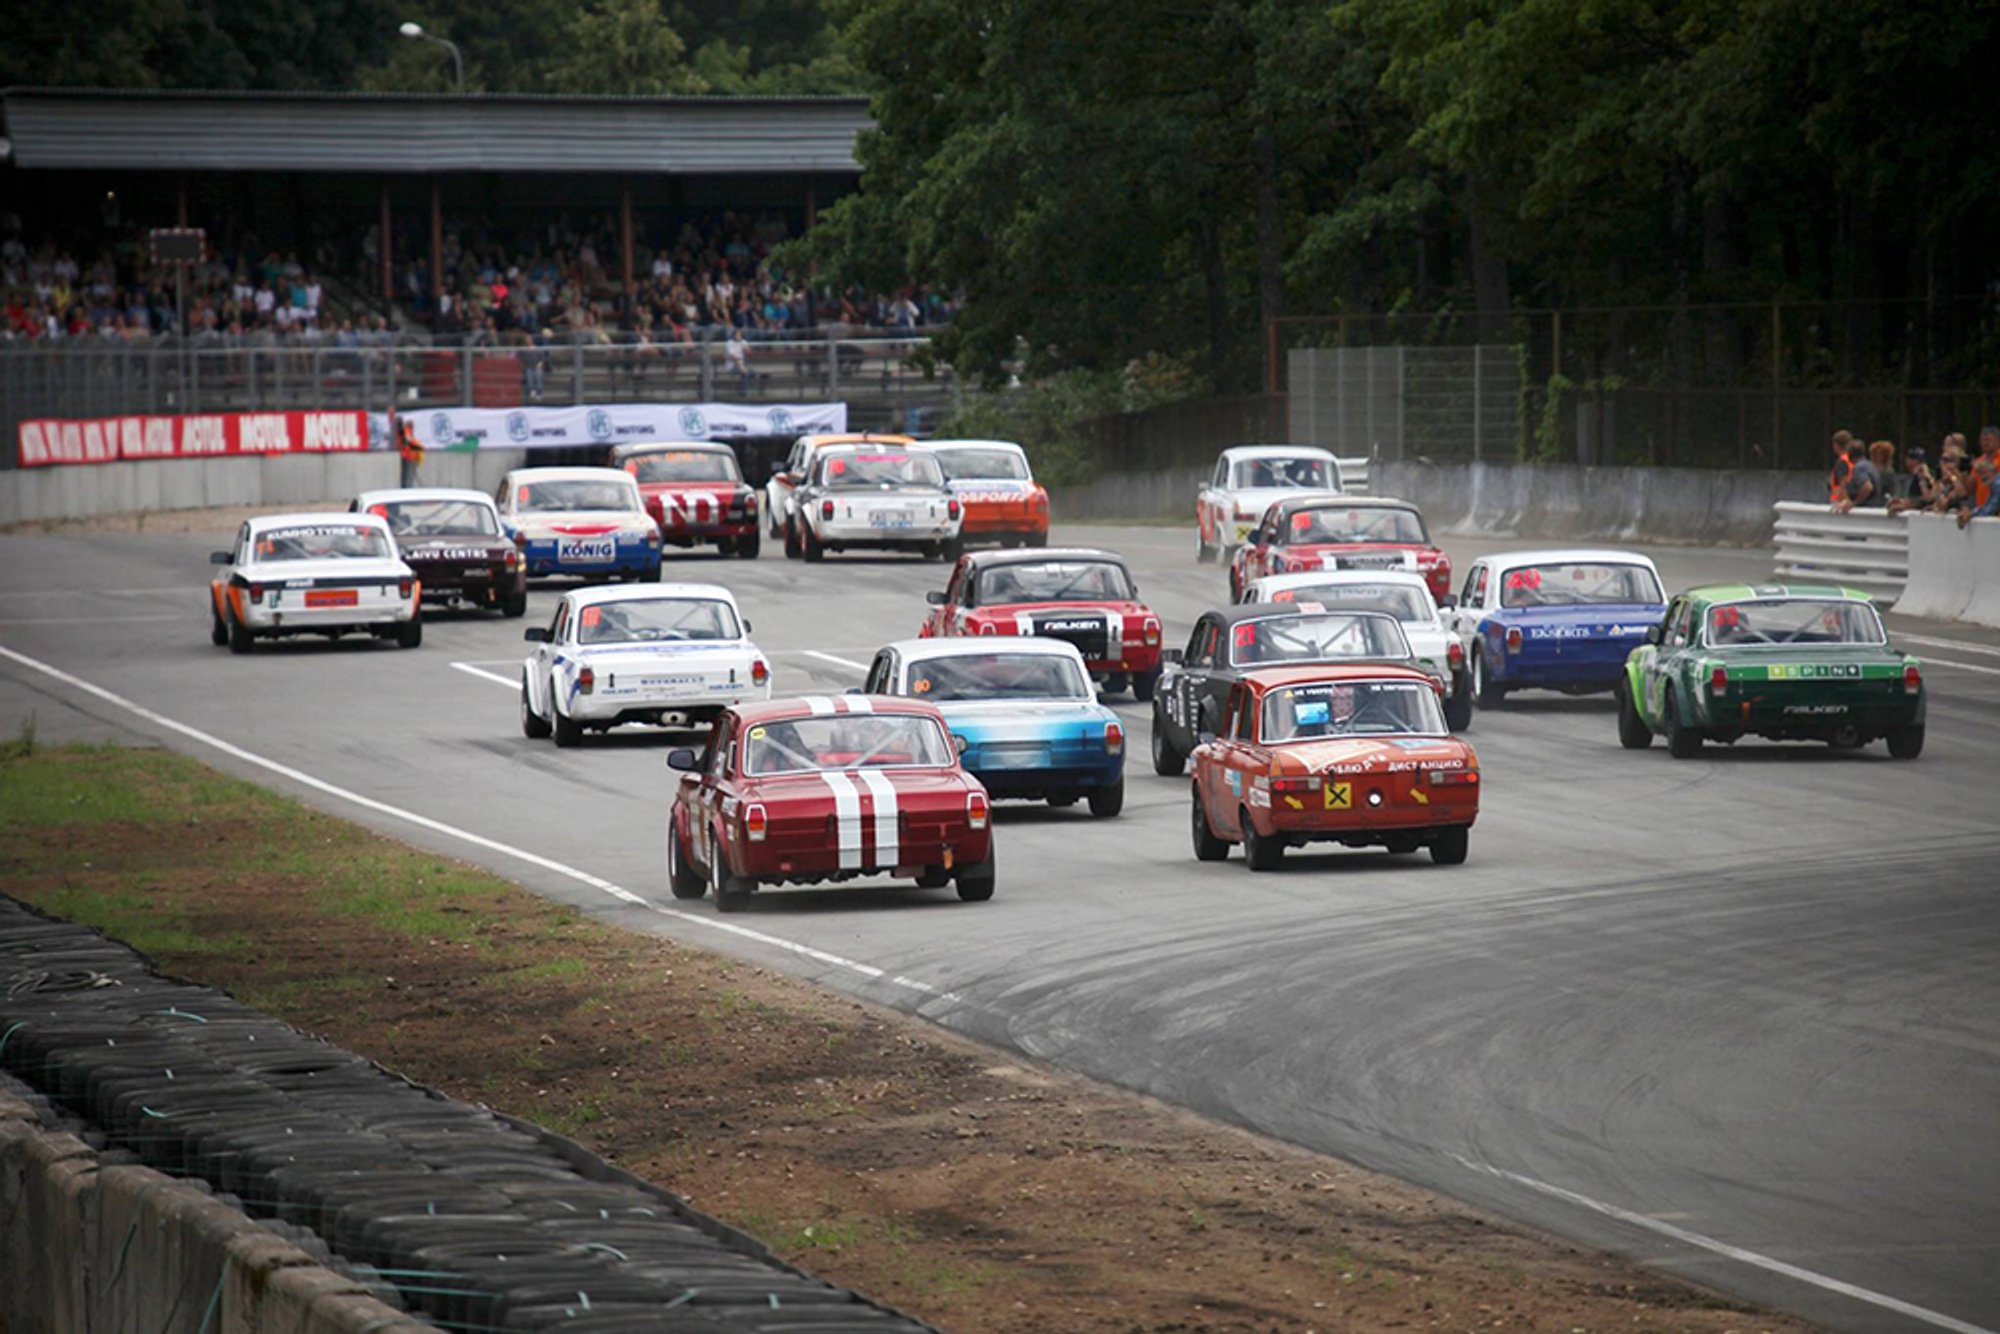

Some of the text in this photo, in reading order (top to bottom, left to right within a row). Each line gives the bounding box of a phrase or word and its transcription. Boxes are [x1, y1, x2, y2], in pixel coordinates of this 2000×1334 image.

[240, 414, 290, 450] MOTUL
[304, 412, 361, 448] MOTUL
[267, 528, 315, 539] KUMHO
[316, 527, 355, 536] TYRES
[443, 549, 488, 559] CENTRS
[1044, 621, 1100, 630] FALKEN
[1235, 624, 1255, 647] 21
